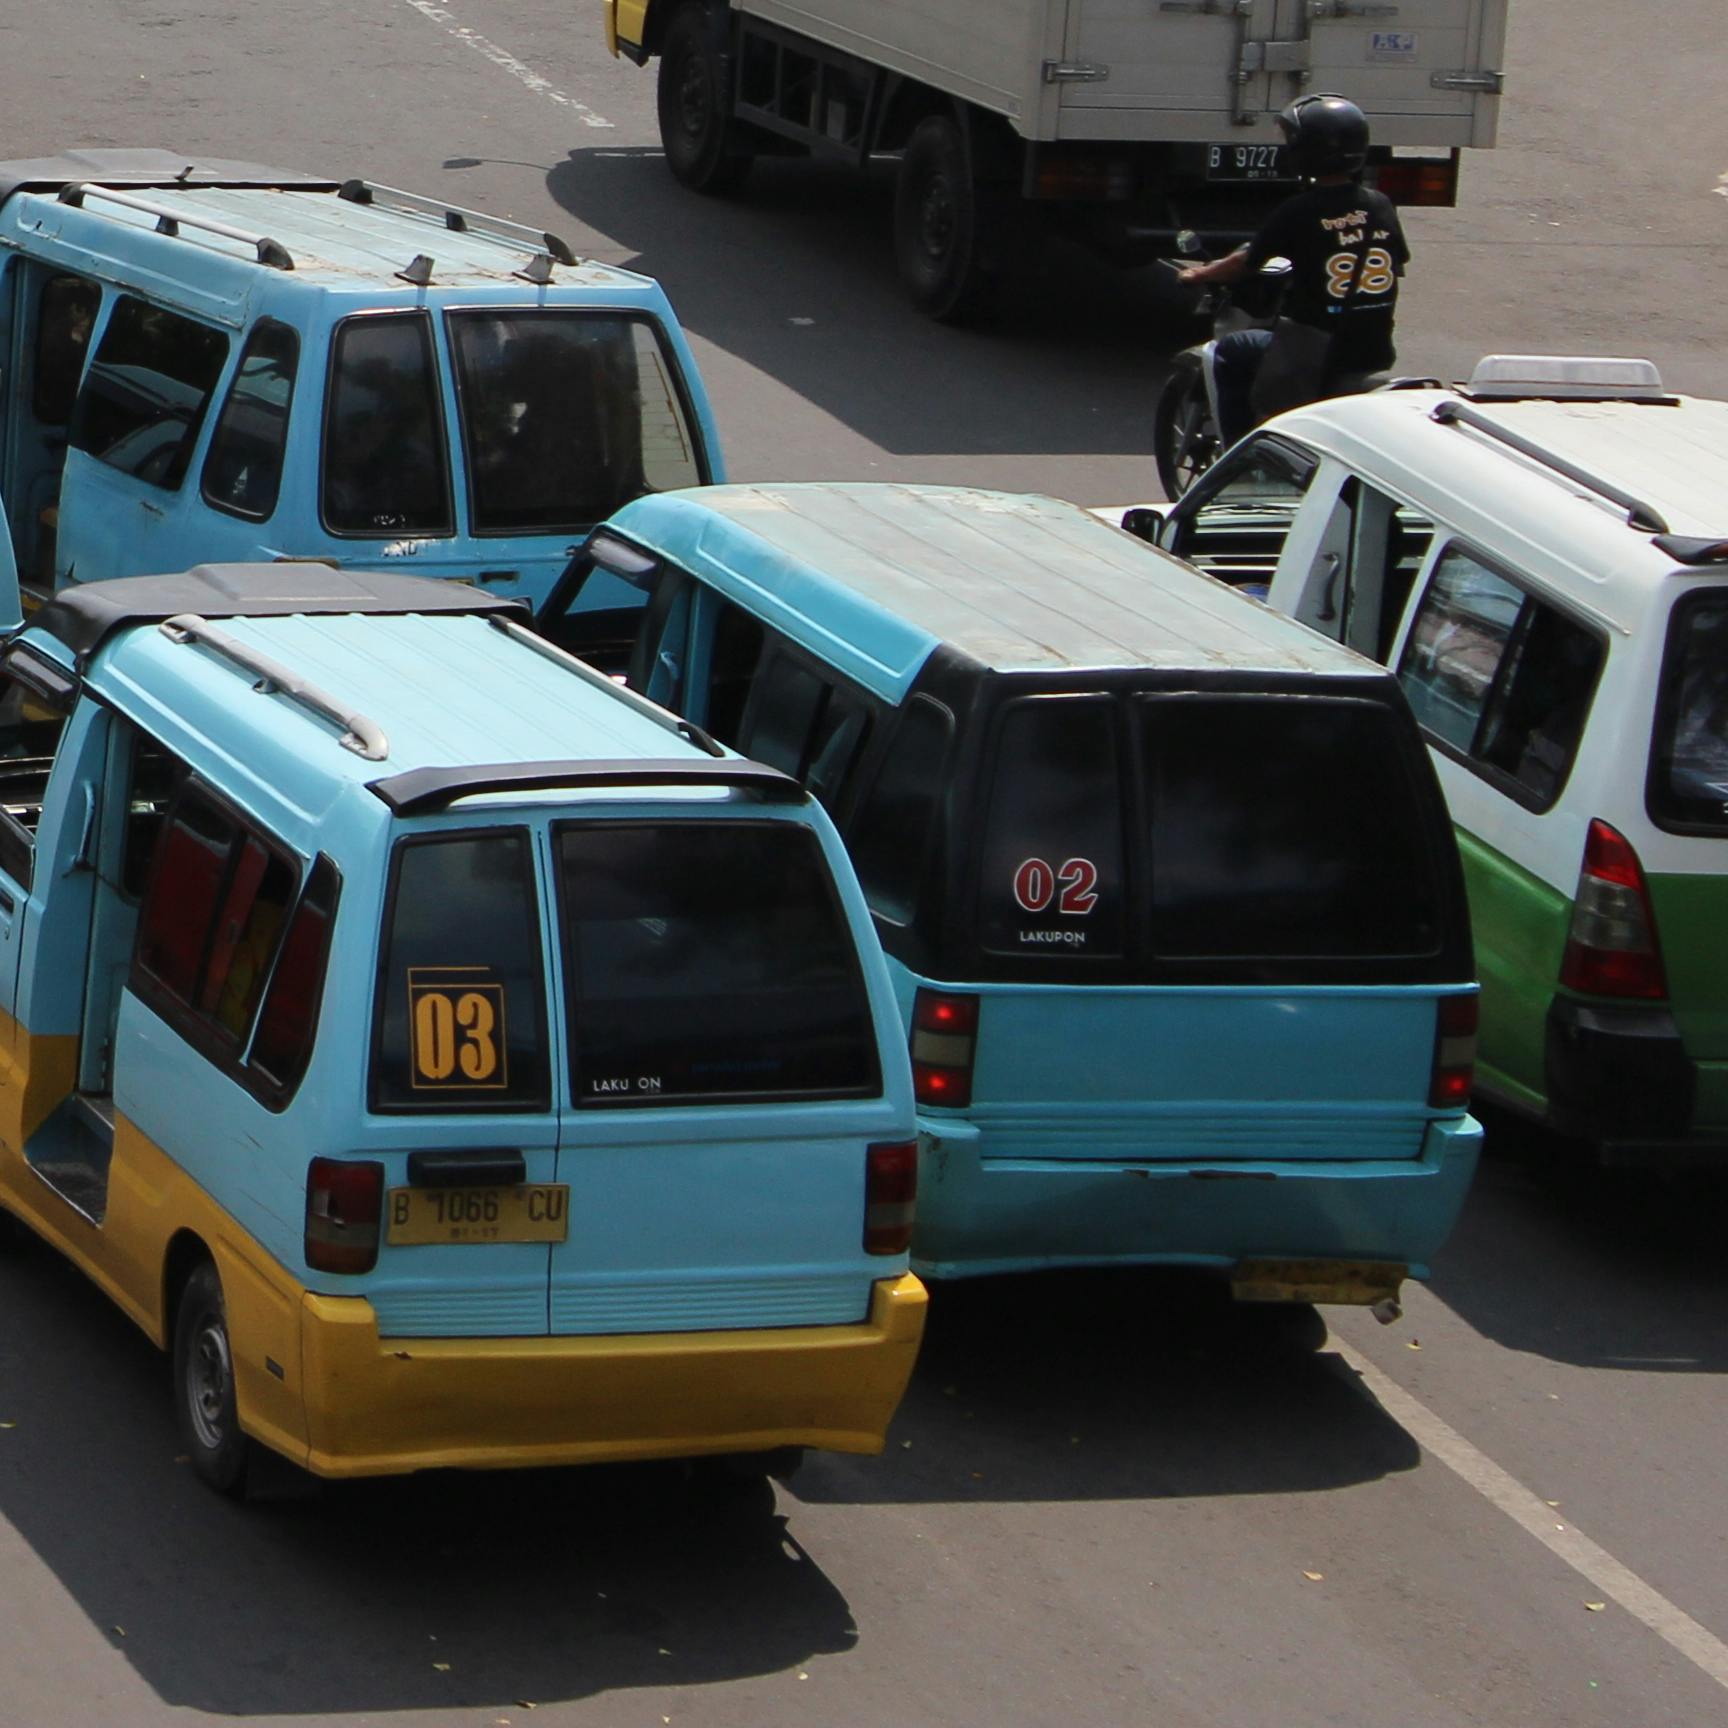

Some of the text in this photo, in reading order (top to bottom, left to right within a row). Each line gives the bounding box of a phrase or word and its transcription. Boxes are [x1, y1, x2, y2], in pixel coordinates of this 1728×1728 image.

[1209, 146, 1279, 168] B 9727
[1326, 247, 1393, 298] 88
[1013, 857, 1098, 914] 02
[1019, 931, 1085, 942] LAKUPON
[416, 993, 496, 1080] 03
[394, 1190, 563, 1226] B 1066 CU
